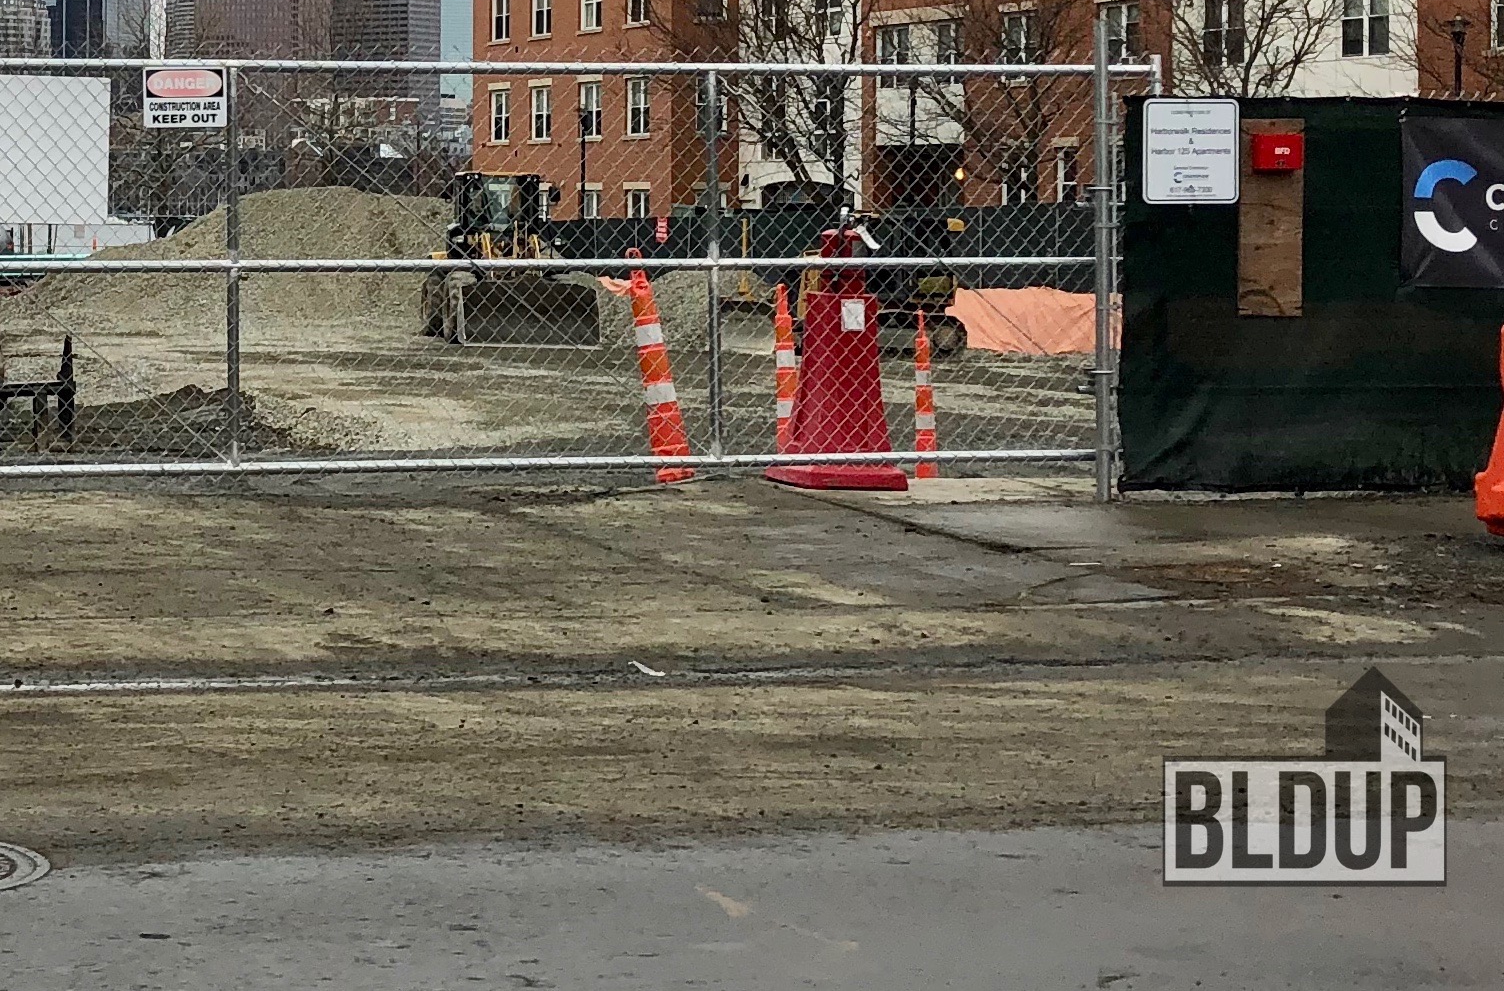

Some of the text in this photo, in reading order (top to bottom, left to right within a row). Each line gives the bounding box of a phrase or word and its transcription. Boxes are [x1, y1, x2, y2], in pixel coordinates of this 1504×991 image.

[153, 77, 216, 90] DANGER
[149, 102, 221, 111] CONSTRUCTION AREA
[152, 114, 218, 124] KEEP OUT
